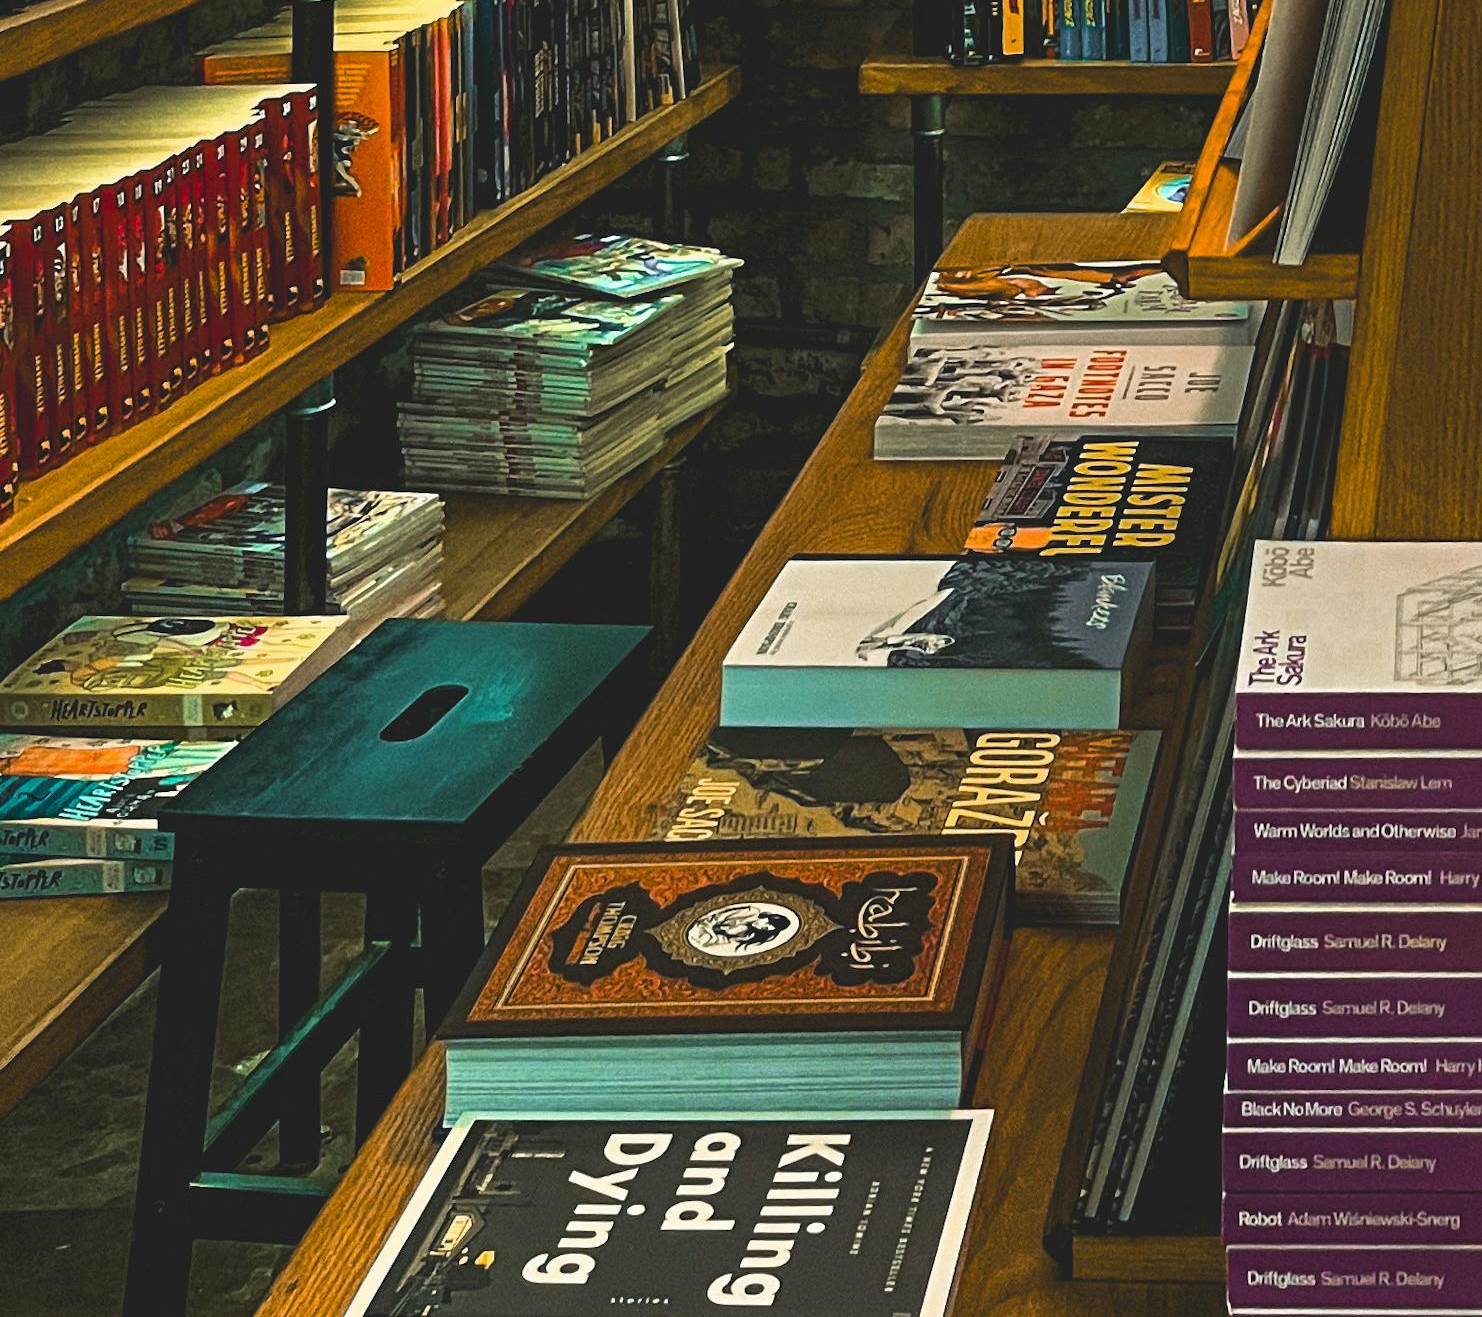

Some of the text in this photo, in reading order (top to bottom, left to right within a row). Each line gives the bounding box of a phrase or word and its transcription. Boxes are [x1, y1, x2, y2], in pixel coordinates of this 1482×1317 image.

[1022, 357, 1078, 409] IN GAZA
[1068, 349, 1128, 418] FOOTNOTES
[1134, 365, 1178, 401] SACCO
[1184, 371, 1222, 394] JOE
[1039, 441, 1140, 557] WONDERF
[1111, 463, 1194, 548] MISTER
[1289, 546, 1316, 580] Abe
[1248, 629, 1281, 686] The Ark
[1275, 634, 1308, 687] Sakura
[50, 697, 149, 723] HEARTSTOPPER
[1256, 712, 1441, 728] The Ark Sakura Abe
[691, 777, 741, 806] JOE
[1253, 775, 1453, 793] The Cyberiad Lem
[941, 730, 1061, 867] GORAŽ
[1253, 823, 1298, 839] Warm
[1299, 823, 1350, 839] Worlds
[1352, 823, 1380, 839] and
[1381, 823, 1457, 839] Otherwise
[1251, 870, 1291, 886] Make
[1292, 870, 1341, 886] Room!
[1343, 870, 1384, 886] Make
[1385, 870, 1433, 886] Room!
[1440, 870, 1481, 889] Harry
[1250, 934, 1447, 952] Driftglass Samuel R. Delany
[1248, 1000, 1446, 1018] Driftglass Samuel R. Delany
[1247, 1059, 1286, 1074] Make
[1288, 1059, 1336, 1074] Room!
[1338, 1059, 1379, 1074] Make
[1380, 1059, 1428, 1074] Room!
[1435, 1059, 1476, 1077] Harry
[1241, 1102, 1281, 1117] Black
[1283, 1102, 1304, 1117] No
[1305, 1102, 1343, 1117] More
[1348, 1102, 1402, 1120] George
[1404, 1102, 1419, 1117] S.
[1239, 1154, 1437, 1173] Driftglass Samuel R. Delany
[659, 1131, 743, 1232] and
[521, 1133, 674, 1285] Dying
[706, 1133, 852, 1308] Killing
[1238, 1211, 1331, 1226] Robot Adam
[1247, 1271, 1445, 1289] Driftglass Samuel R. Delany
[609, 1295, 670, 1306] stories
